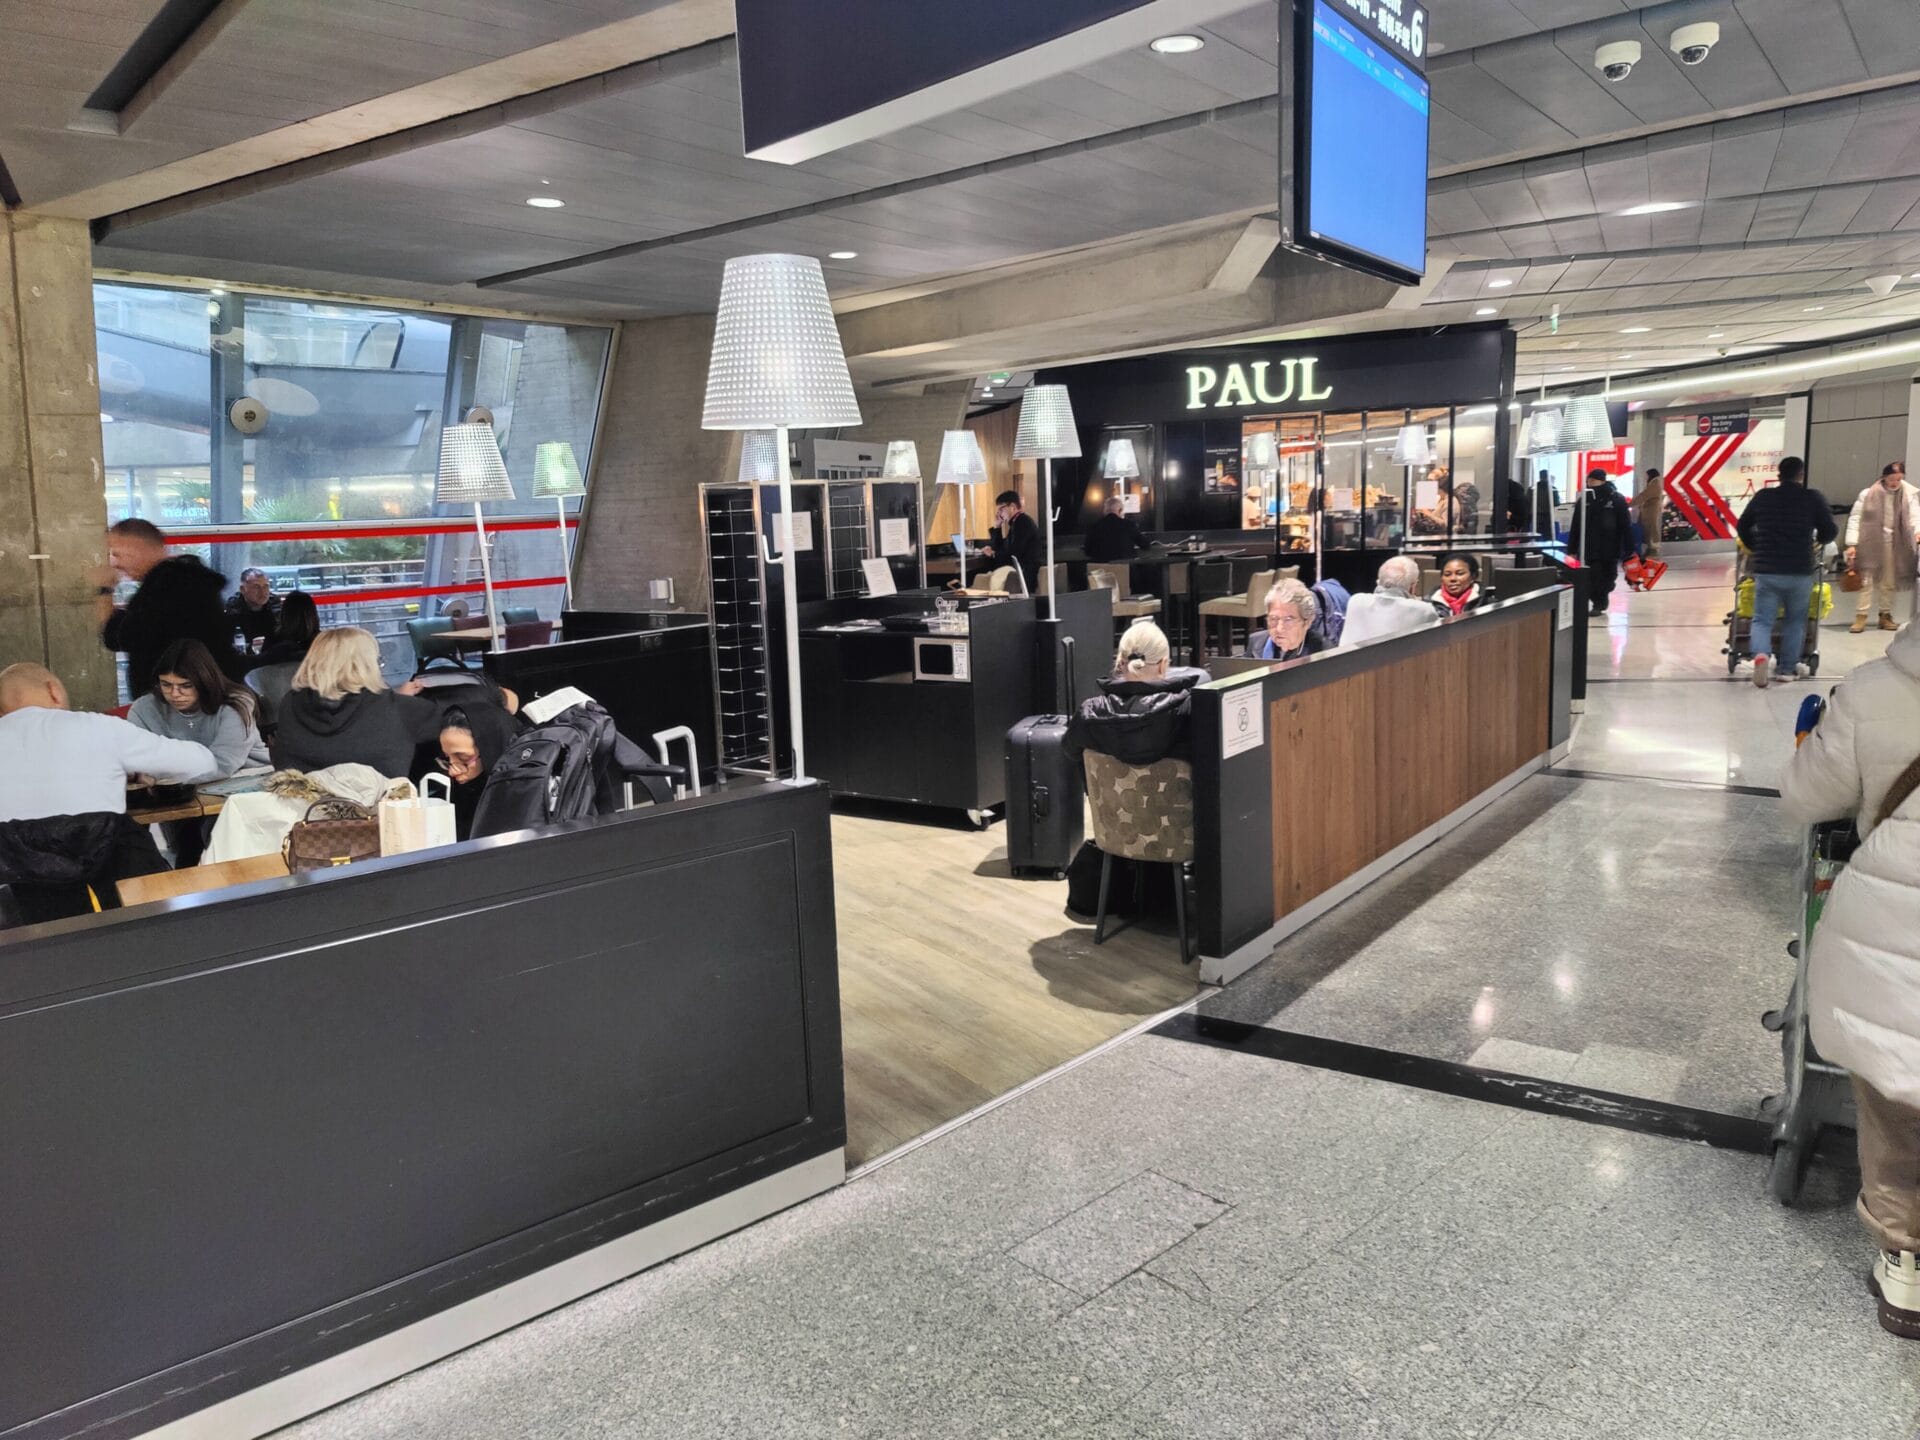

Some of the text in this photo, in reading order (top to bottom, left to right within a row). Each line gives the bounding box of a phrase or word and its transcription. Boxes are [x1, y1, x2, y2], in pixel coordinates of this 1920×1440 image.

[1411, 9, 1424, 58] 6
[1185, 357, 1333, 409] PAUL
[1740, 450, 1784, 458] ENTRANCE
